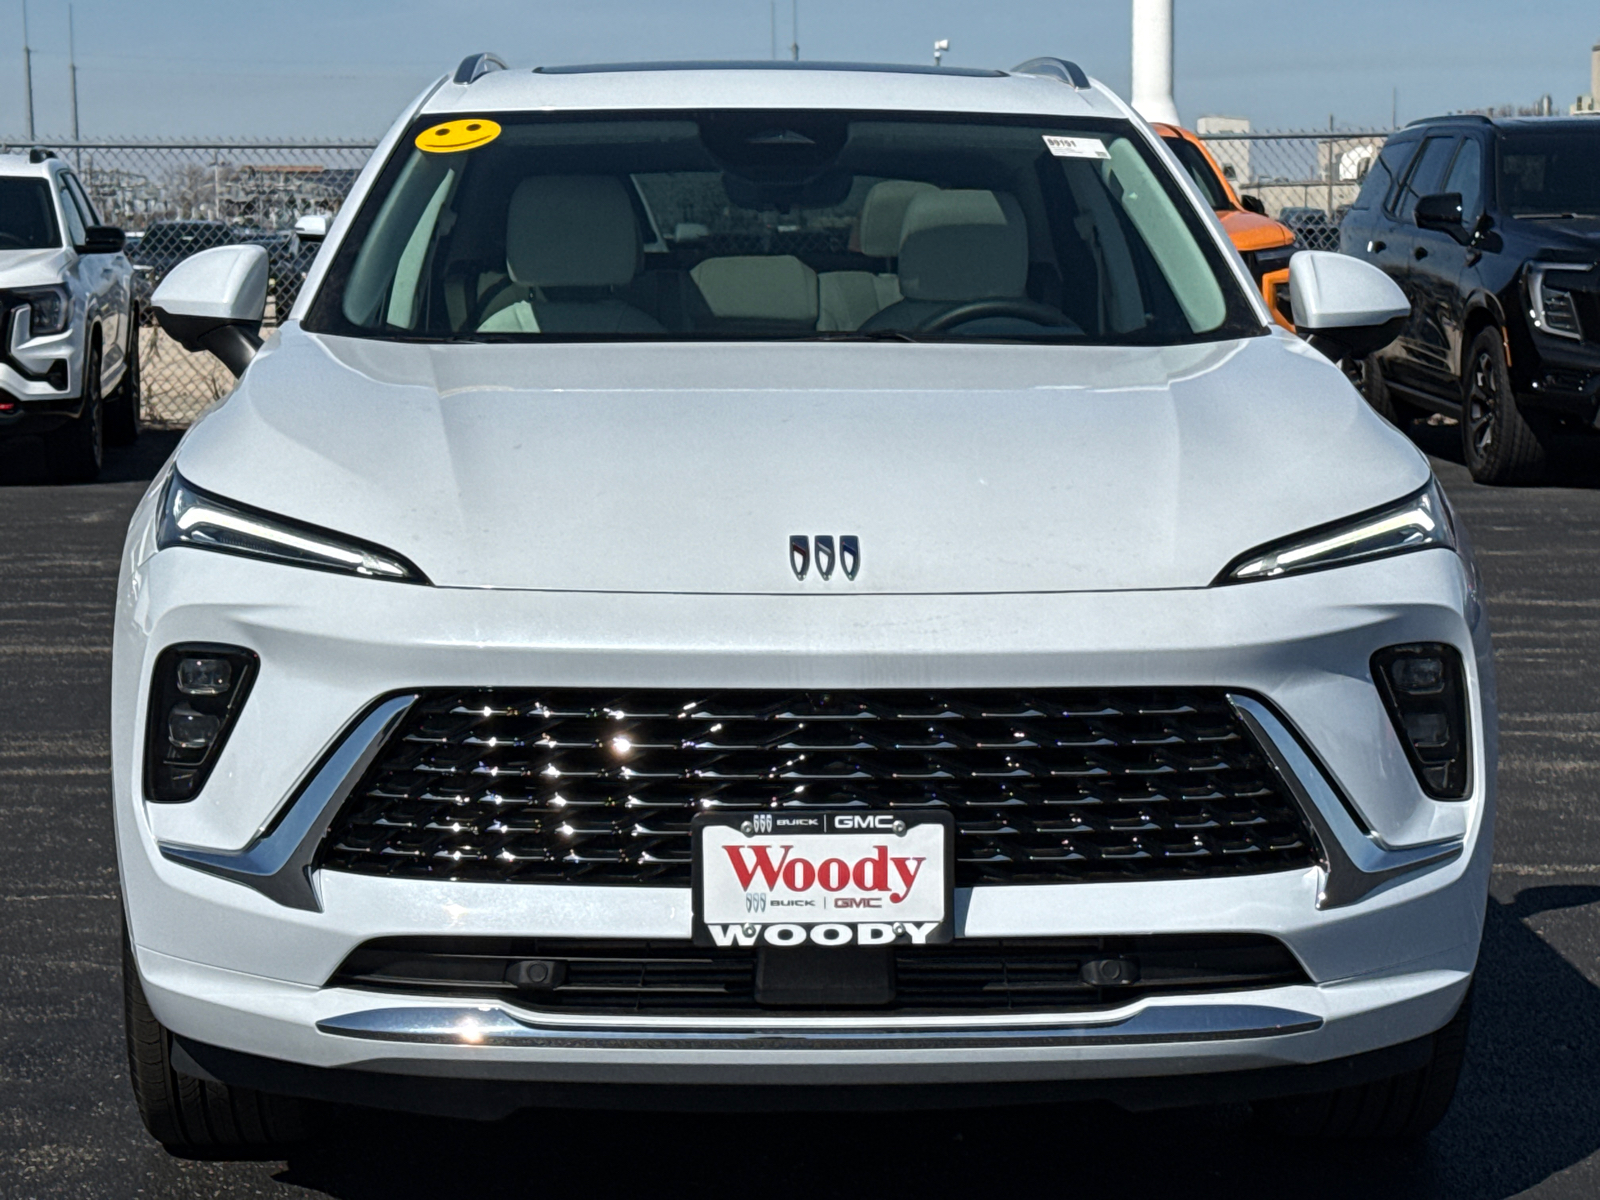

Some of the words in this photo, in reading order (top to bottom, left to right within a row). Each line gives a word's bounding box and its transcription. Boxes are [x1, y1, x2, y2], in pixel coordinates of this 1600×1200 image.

[834, 815, 894, 829] GMC
[722, 845, 926, 904] Woody
[833, 898, 882, 908] GMC
[707, 922, 939, 946] WOODY
